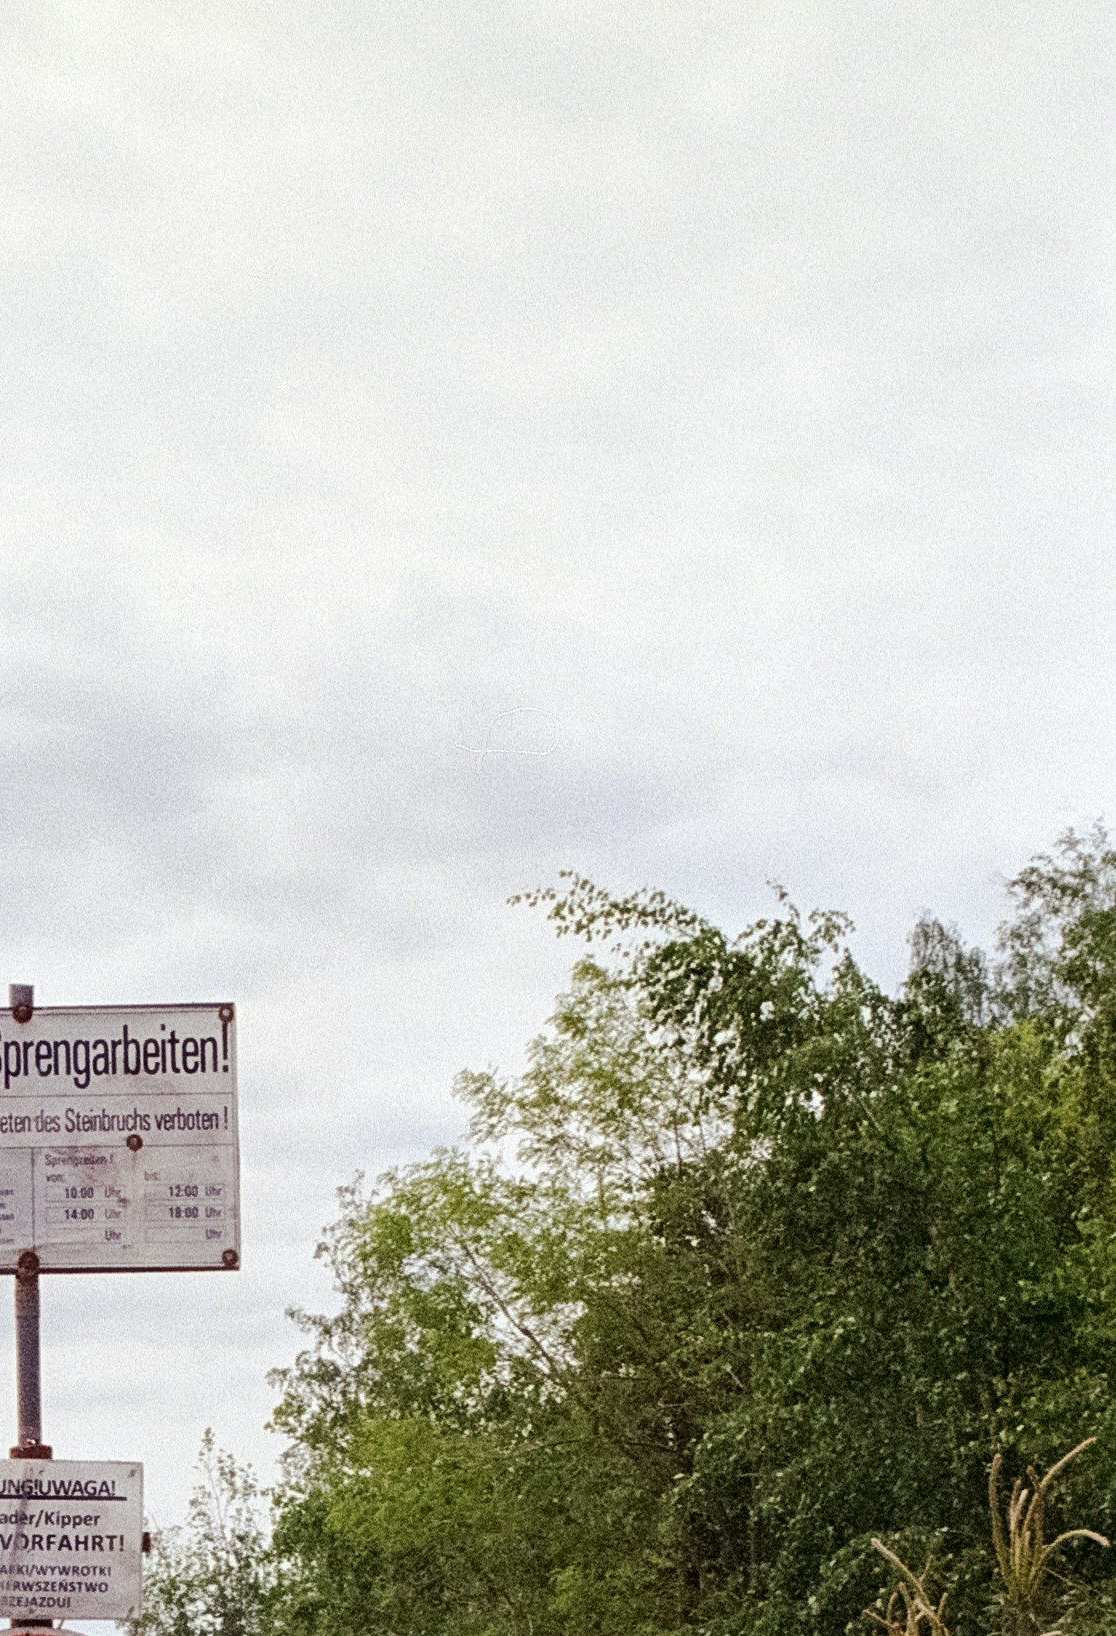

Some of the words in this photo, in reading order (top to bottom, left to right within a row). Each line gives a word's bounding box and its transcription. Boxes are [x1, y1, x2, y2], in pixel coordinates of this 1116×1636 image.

[34, 1109, 61, 1133] des
[64, 1107, 151, 1133] Steinbruchs
[65, 1187, 95, 1199] 10:00
[104, 1186, 122, 1198] Uhr
[169, 1185, 199, 1197] 12:00
[205, 1185, 223, 1197] Uhr
[65, 1208, 95, 1220] 14:00
[104, 1208, 122, 1220] Uhr
[169, 1206, 199, 1219] 18:00
[205, 1206, 222, 1218] Uhr
[104, 1229, 122, 1241] Uhr
[205, 1227, 223, 1240] Uhr
